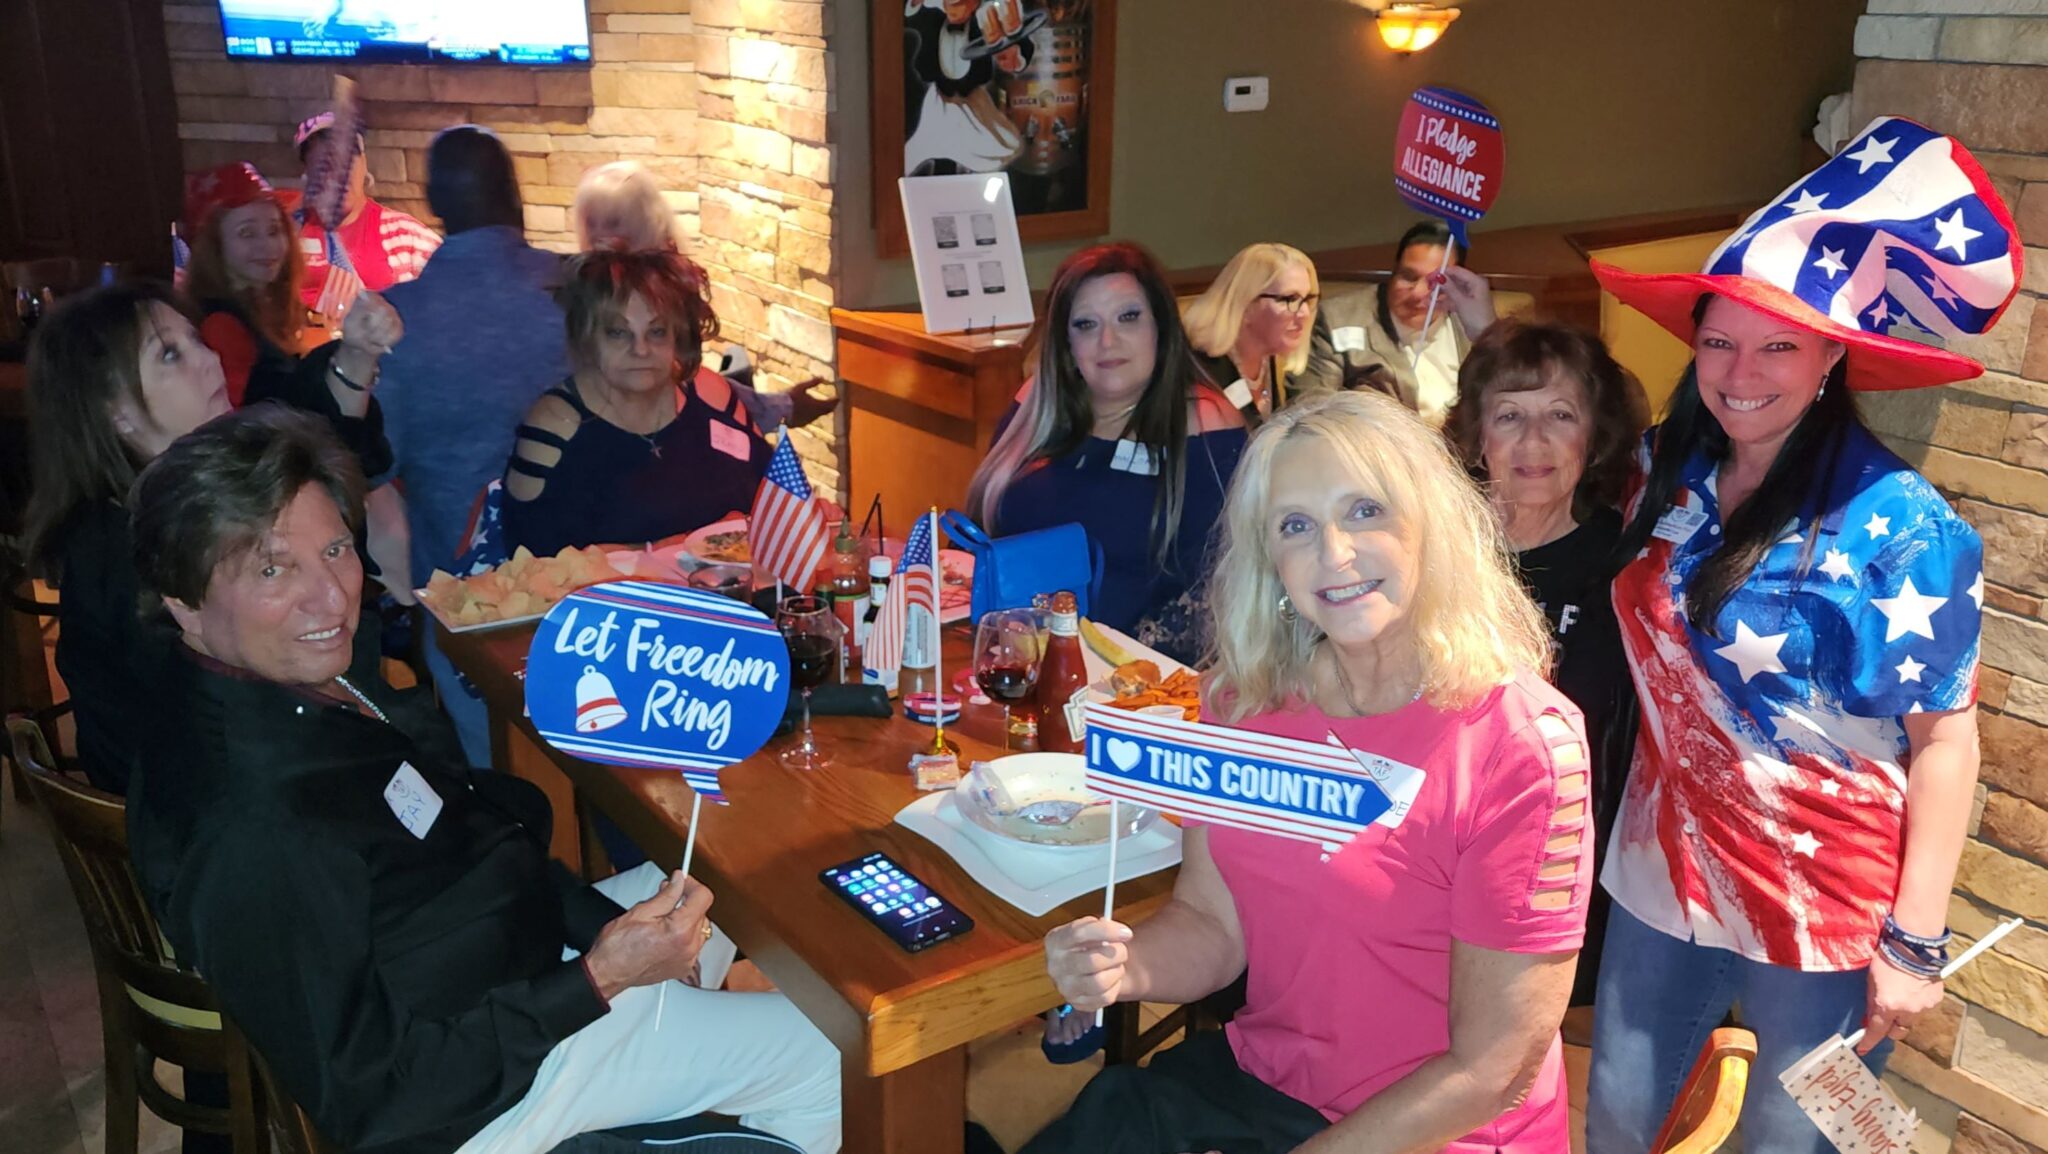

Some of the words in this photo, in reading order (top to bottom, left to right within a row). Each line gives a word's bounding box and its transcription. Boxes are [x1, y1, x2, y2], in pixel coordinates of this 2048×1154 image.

[1415, 113, 1427, 143] I
[1424, 117, 1477, 165] Pledge
[1401, 146, 1486, 202] ALLEGIANCE
[554, 607, 621, 663] Let
[626, 617, 780, 693] Freedom
[640, 679, 732, 751] Ring
[1091, 732, 1101, 766] I
[1145, 745, 1213, 792] THIS
[1220, 760, 1366, 820] COUNTRY
[400, 790, 426, 830] JAY
